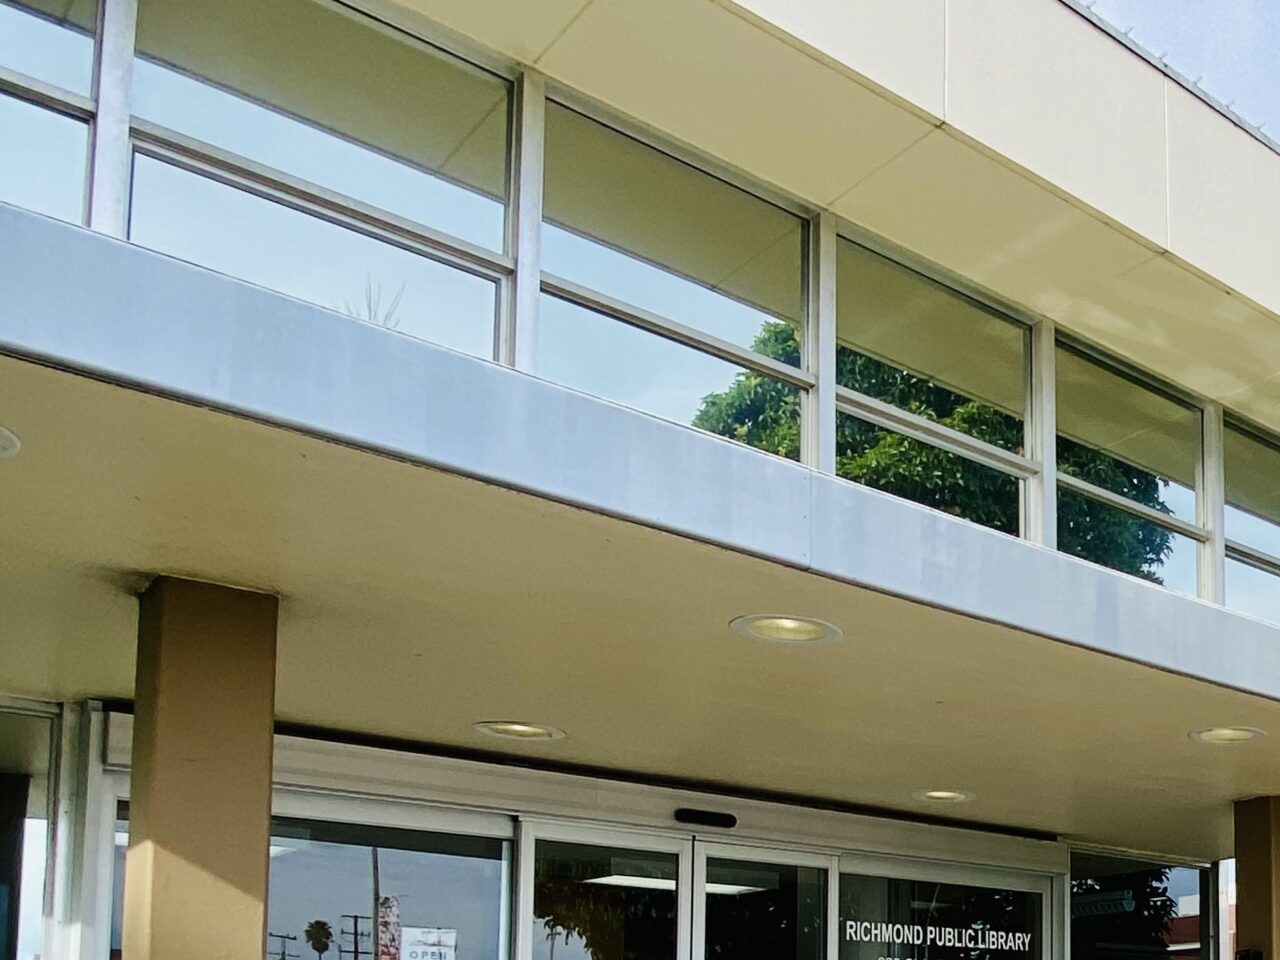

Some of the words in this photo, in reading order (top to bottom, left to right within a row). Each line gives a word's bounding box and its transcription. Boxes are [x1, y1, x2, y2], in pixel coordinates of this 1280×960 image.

[845, 920, 923, 945] RICHMOND
[926, 926, 975, 948] PUBLIC
[978, 930, 1031, 951] LIBRARY
[409, 951, 447, 960] OPEN
